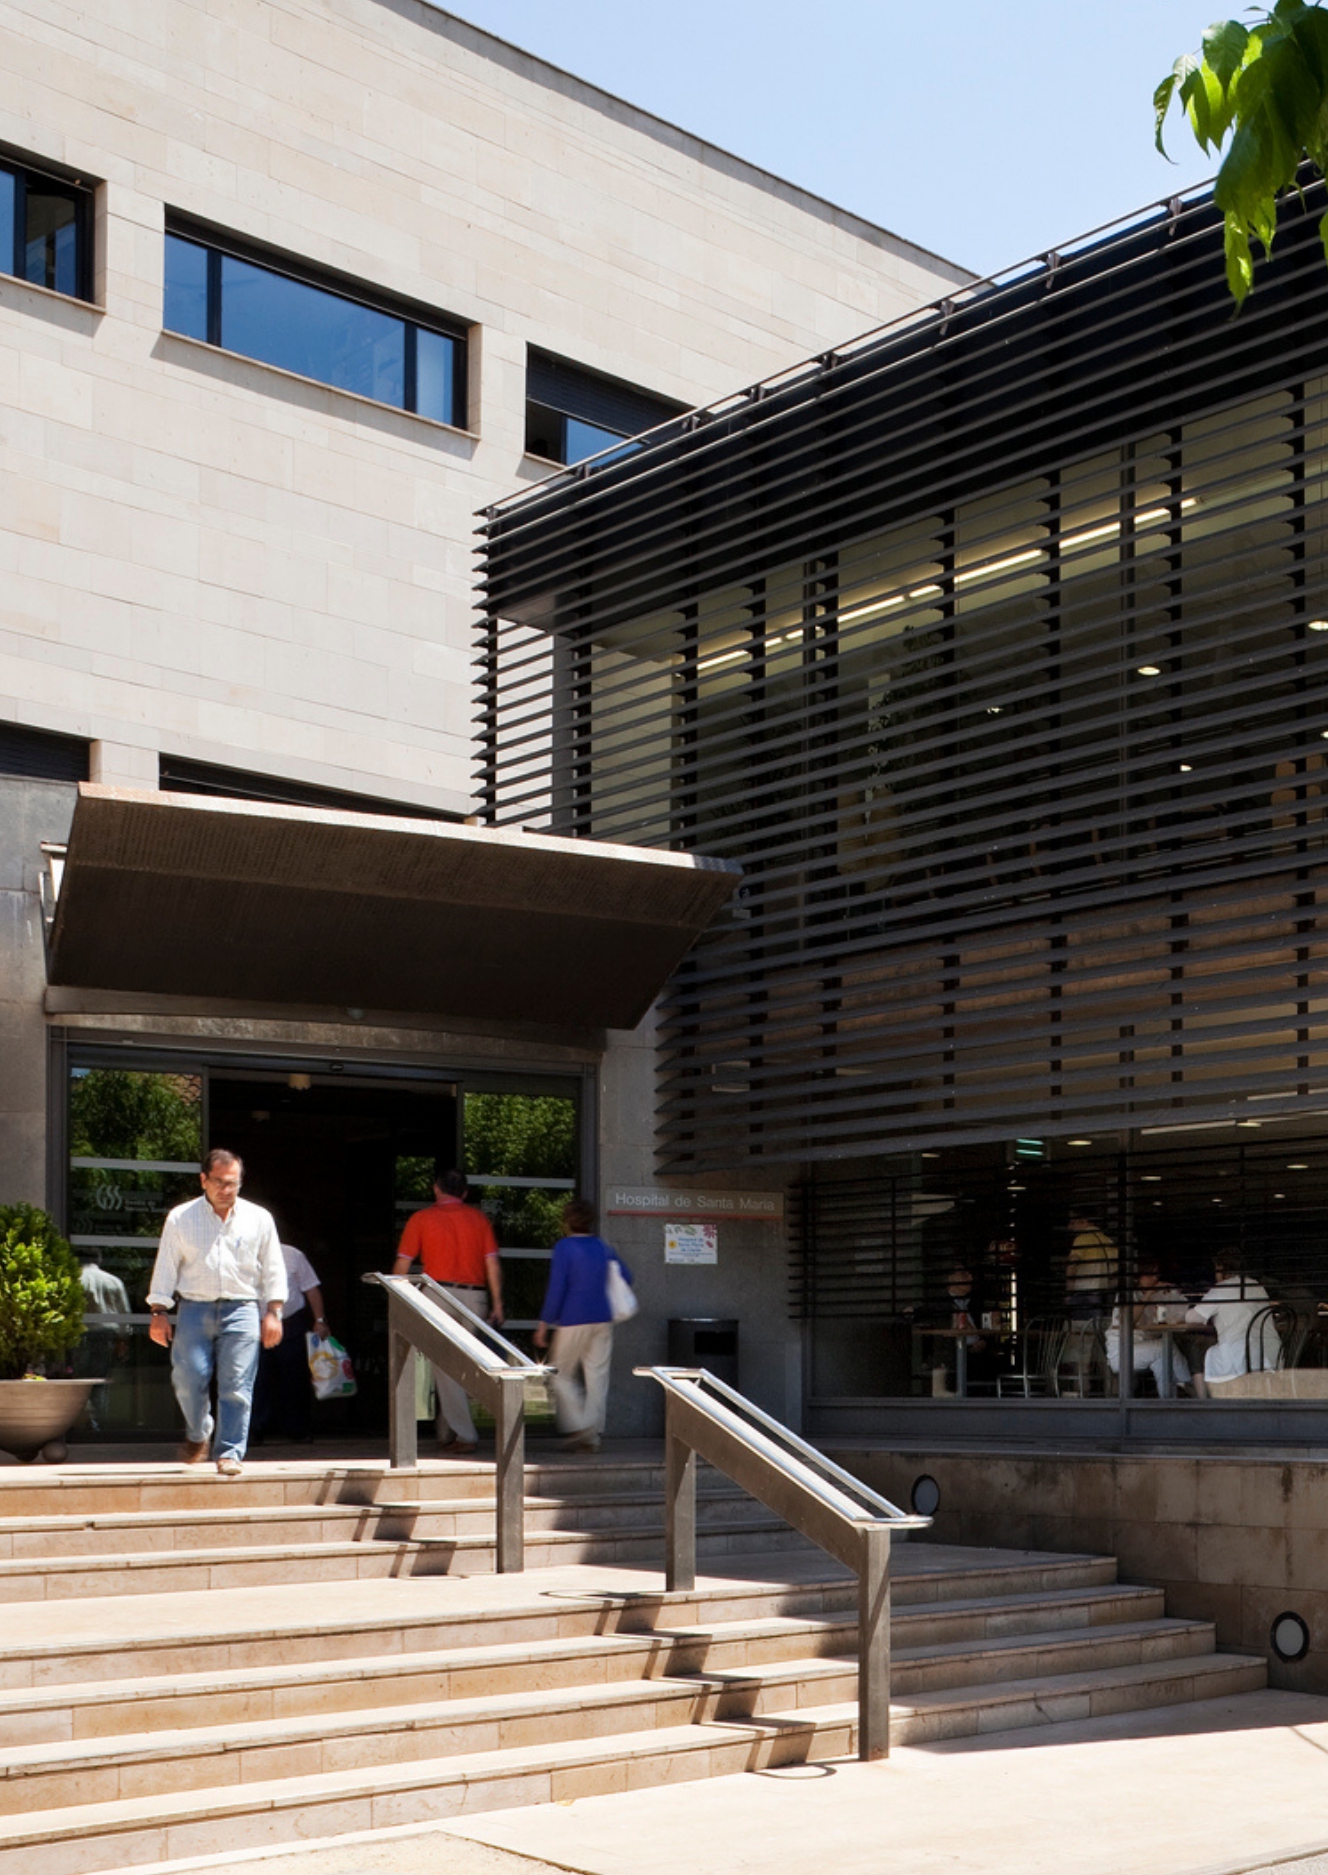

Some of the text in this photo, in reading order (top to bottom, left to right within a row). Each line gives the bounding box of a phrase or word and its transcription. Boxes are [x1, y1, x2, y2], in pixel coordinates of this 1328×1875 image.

[615, 1193, 775, 1211] Hospital de Santa Maria
